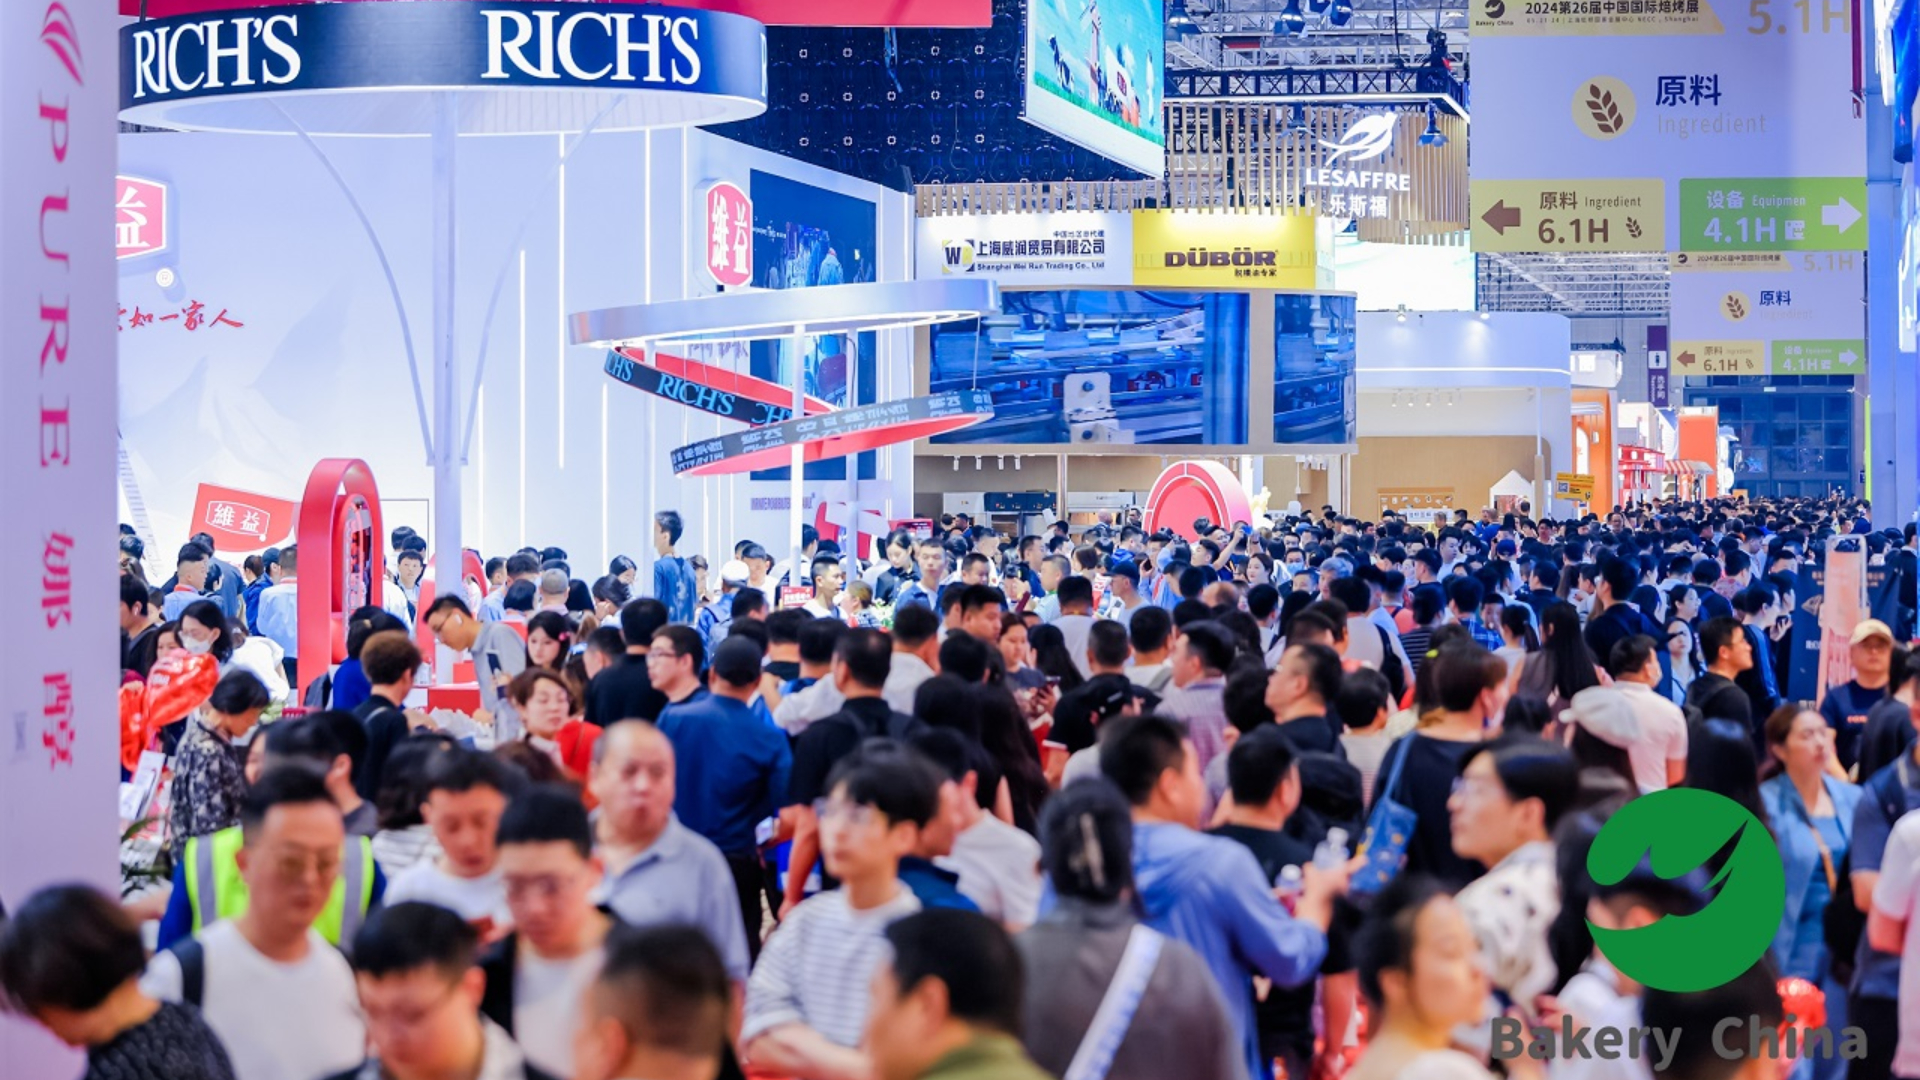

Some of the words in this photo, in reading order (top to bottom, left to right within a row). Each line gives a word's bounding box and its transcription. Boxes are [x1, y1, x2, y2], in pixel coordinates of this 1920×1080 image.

[1747, 0, 1850, 35] 5.1H
[133, 14, 301, 98] RICH'S
[480, 10, 701, 86] RICH'S
[1655, 74, 1722, 106] 原料
[1657, 113, 1768, 140] Ingredient
[1306, 168, 1411, 192] LESAFFRE
[1328, 193, 1389, 218] 乐斯福
[1540, 190, 1578, 211] 原料
[1584, 195, 1642, 211] Ingredient
[1706, 190, 1745, 209] 设备
[1538, 218, 1609, 244] 6.1H
[1703, 217, 1777, 243] 4.1H
[976, 239, 1105, 256] 上海威润贸易有限公司
[977, 263, 1011, 272] Shanghai
[1045, 262, 1074, 271] Trading
[1803, 254, 1854, 271] 5.1H
[1759, 290, 1791, 306] 原料
[1703, 359, 1738, 371] 6.1H
[1783, 358, 1818, 371] 4.1H
[656, 372, 736, 416] RICH'S
